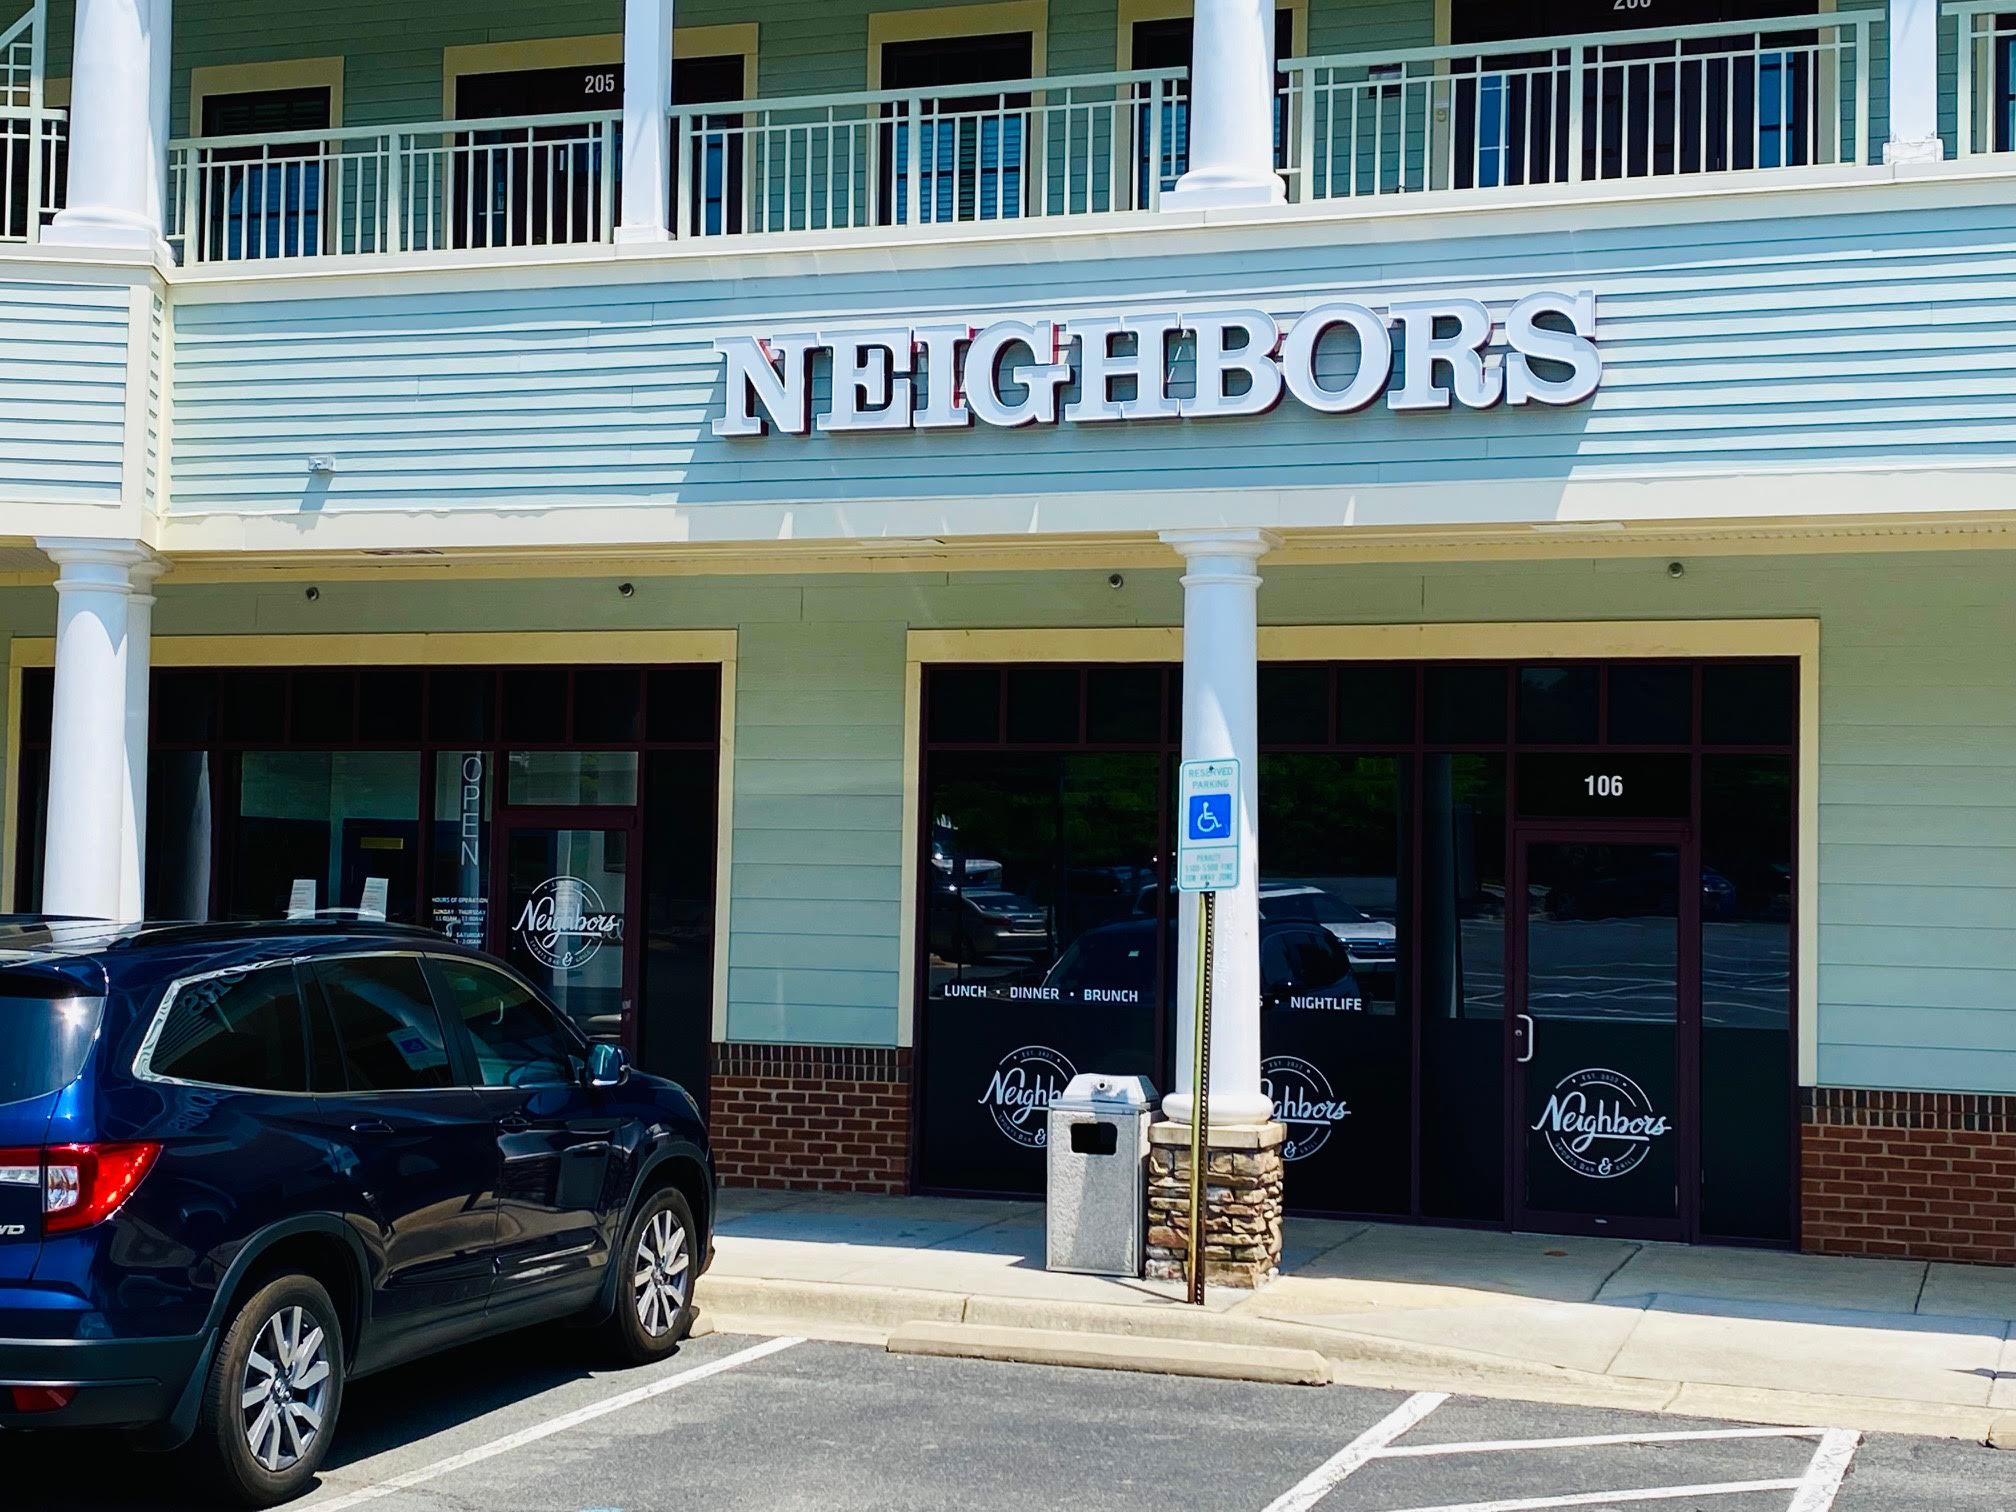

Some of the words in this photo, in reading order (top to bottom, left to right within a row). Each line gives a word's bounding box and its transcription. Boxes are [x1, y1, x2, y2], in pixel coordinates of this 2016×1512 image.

[584, 73, 615, 94] 205
[712, 289, 1603, 437] NEIGHBORS
[1188, 766, 1234, 778] RESERVED
[1192, 779, 1229, 789] PARKING
[1584, 774, 1624, 797] 106
[461, 756, 482, 866] OPEN
[511, 896, 620, 949] Neighbors
[944, 984, 987, 998] LUNCH
[1010, 986, 1060, 1000] DINNER
[1083, 988, 1139, 1003] BRUNCH
[1290, 996, 1362, 1011] NIGHTLIFE
[978, 1067, 1063, 1125] Neighb
[1531, 1091, 1672, 1153] Neighbors
[1034, 1128, 1046, 1145] &
[1284, 1140, 1297, 1158] &
[1598, 1157, 1613, 1176] &
